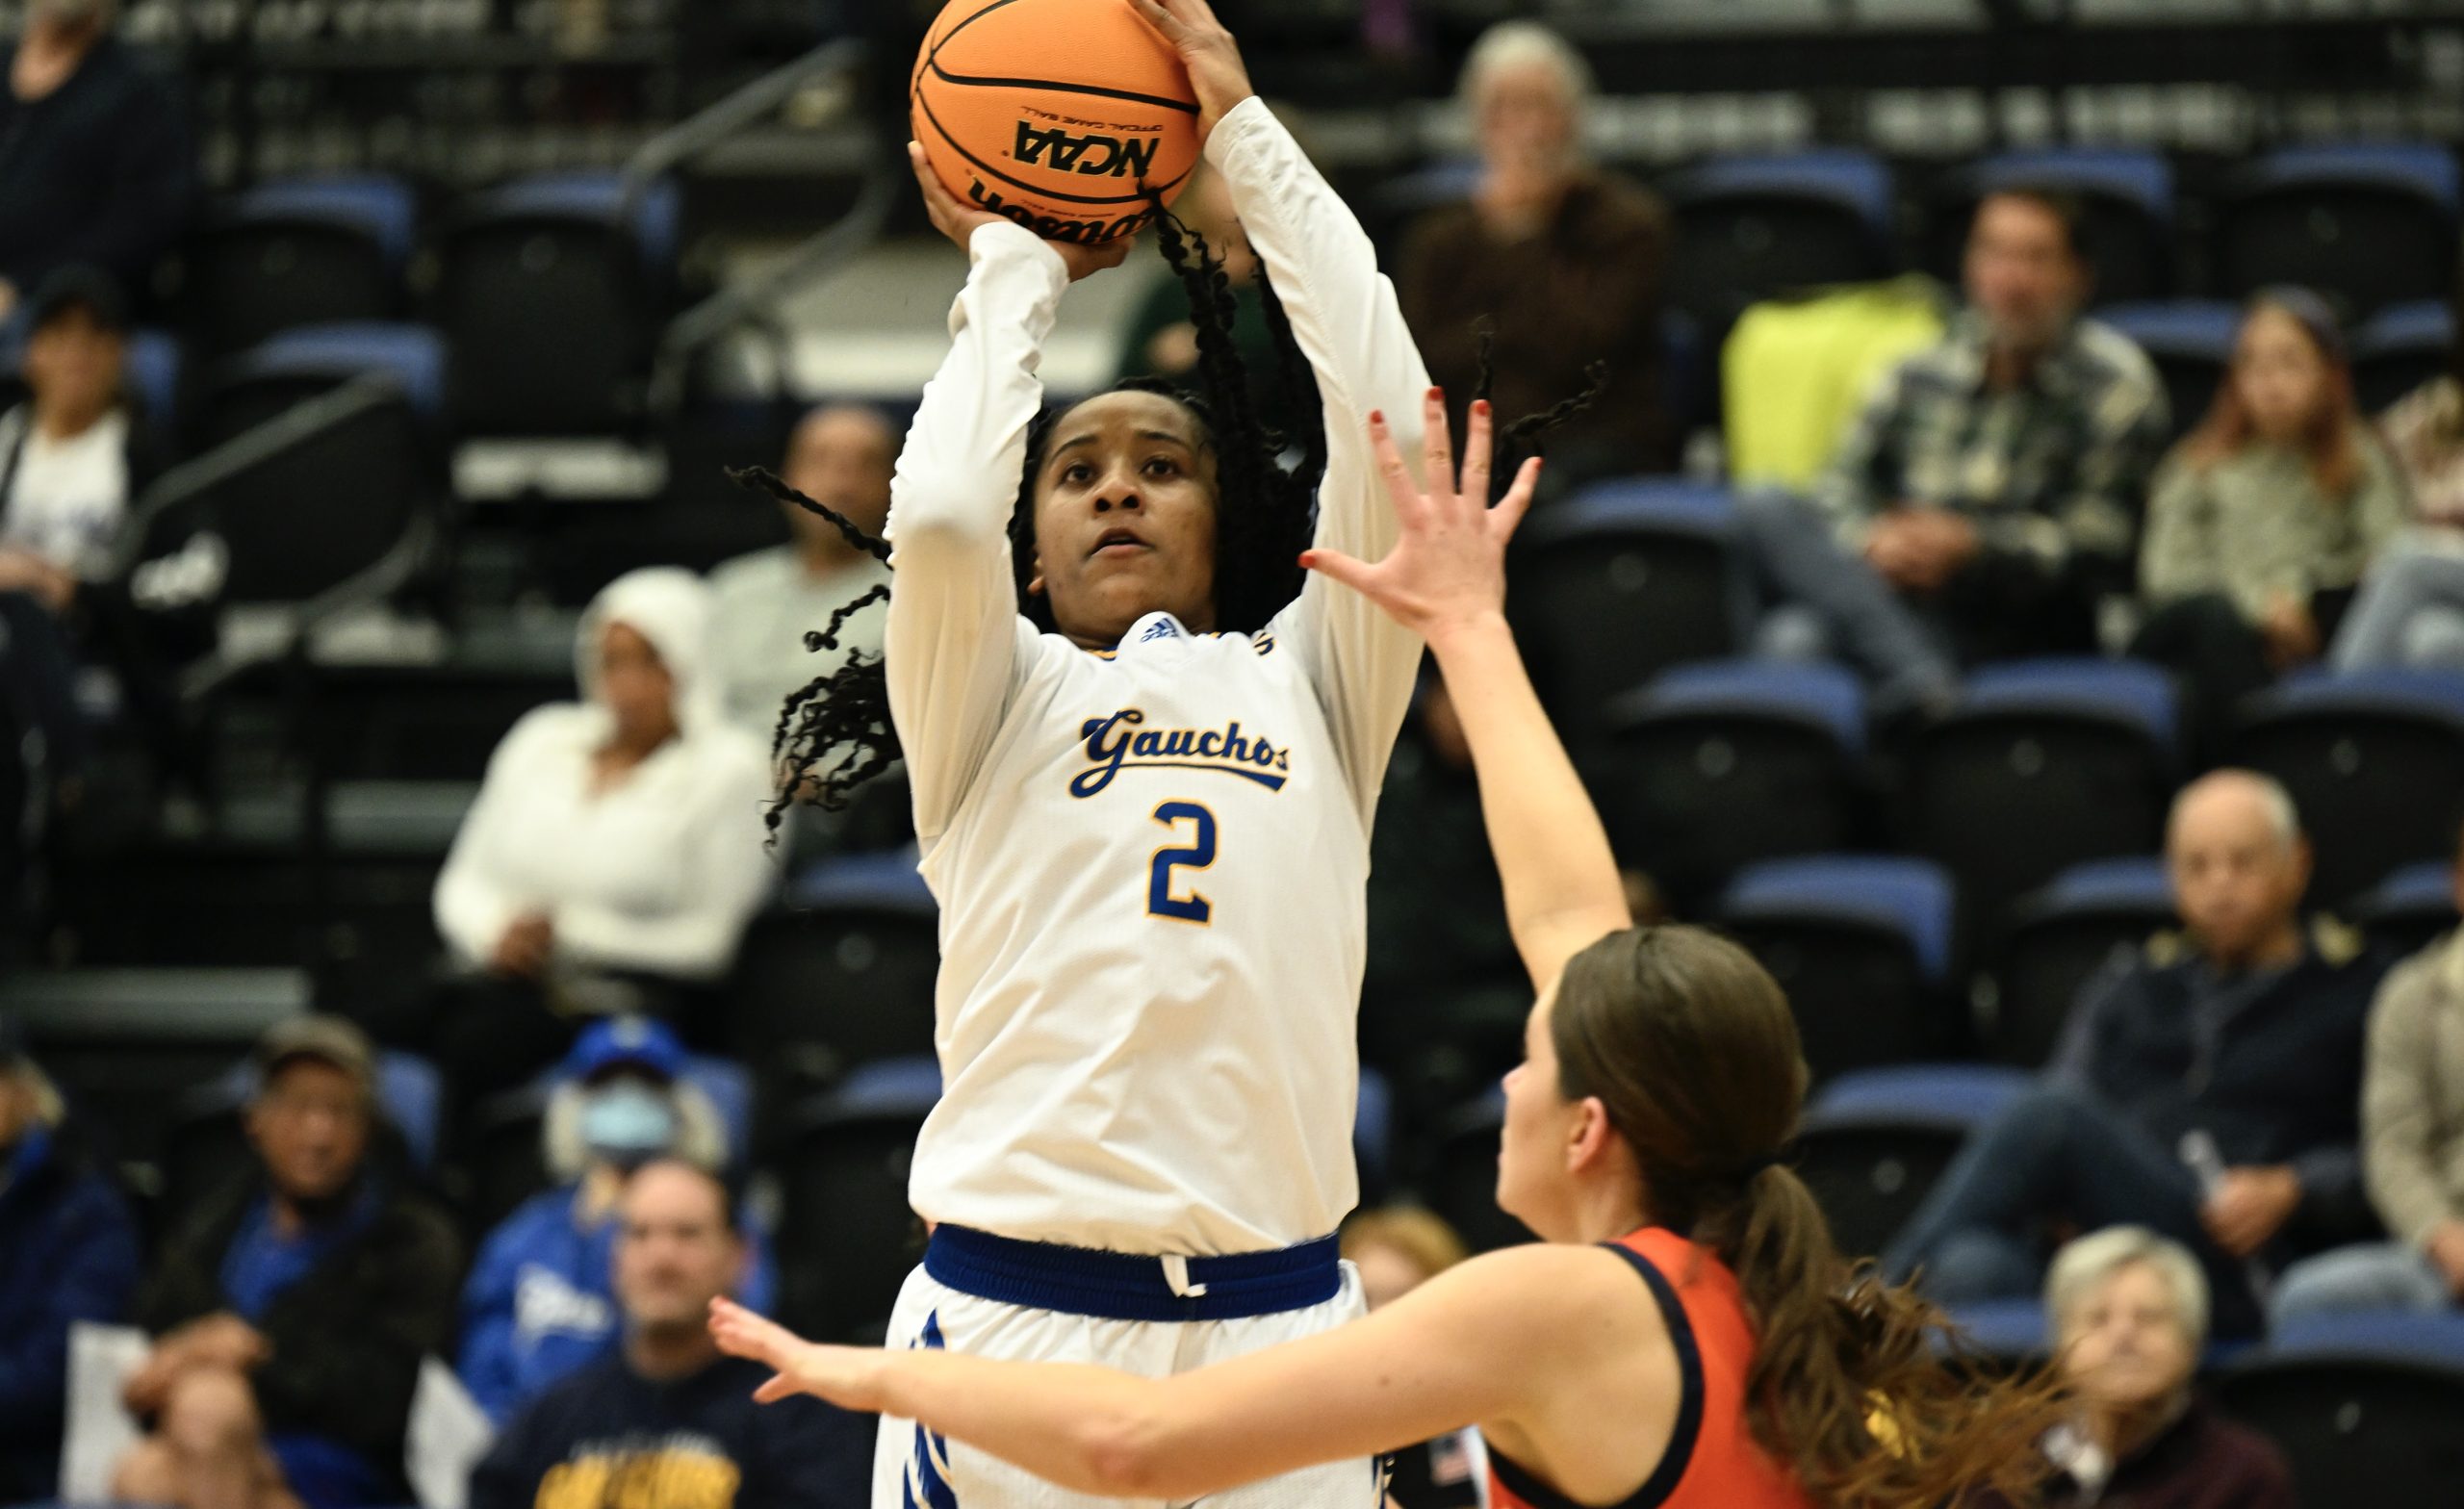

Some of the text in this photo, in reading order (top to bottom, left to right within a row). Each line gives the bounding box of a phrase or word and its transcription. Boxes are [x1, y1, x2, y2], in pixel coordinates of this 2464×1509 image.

[1014, 119, 1161, 178] NCAA
[1020, 106, 1164, 132] OFFICIAL GAME BALL
[1068, 708, 1290, 799] Gauchos
[1146, 798, 1219, 927] 2
